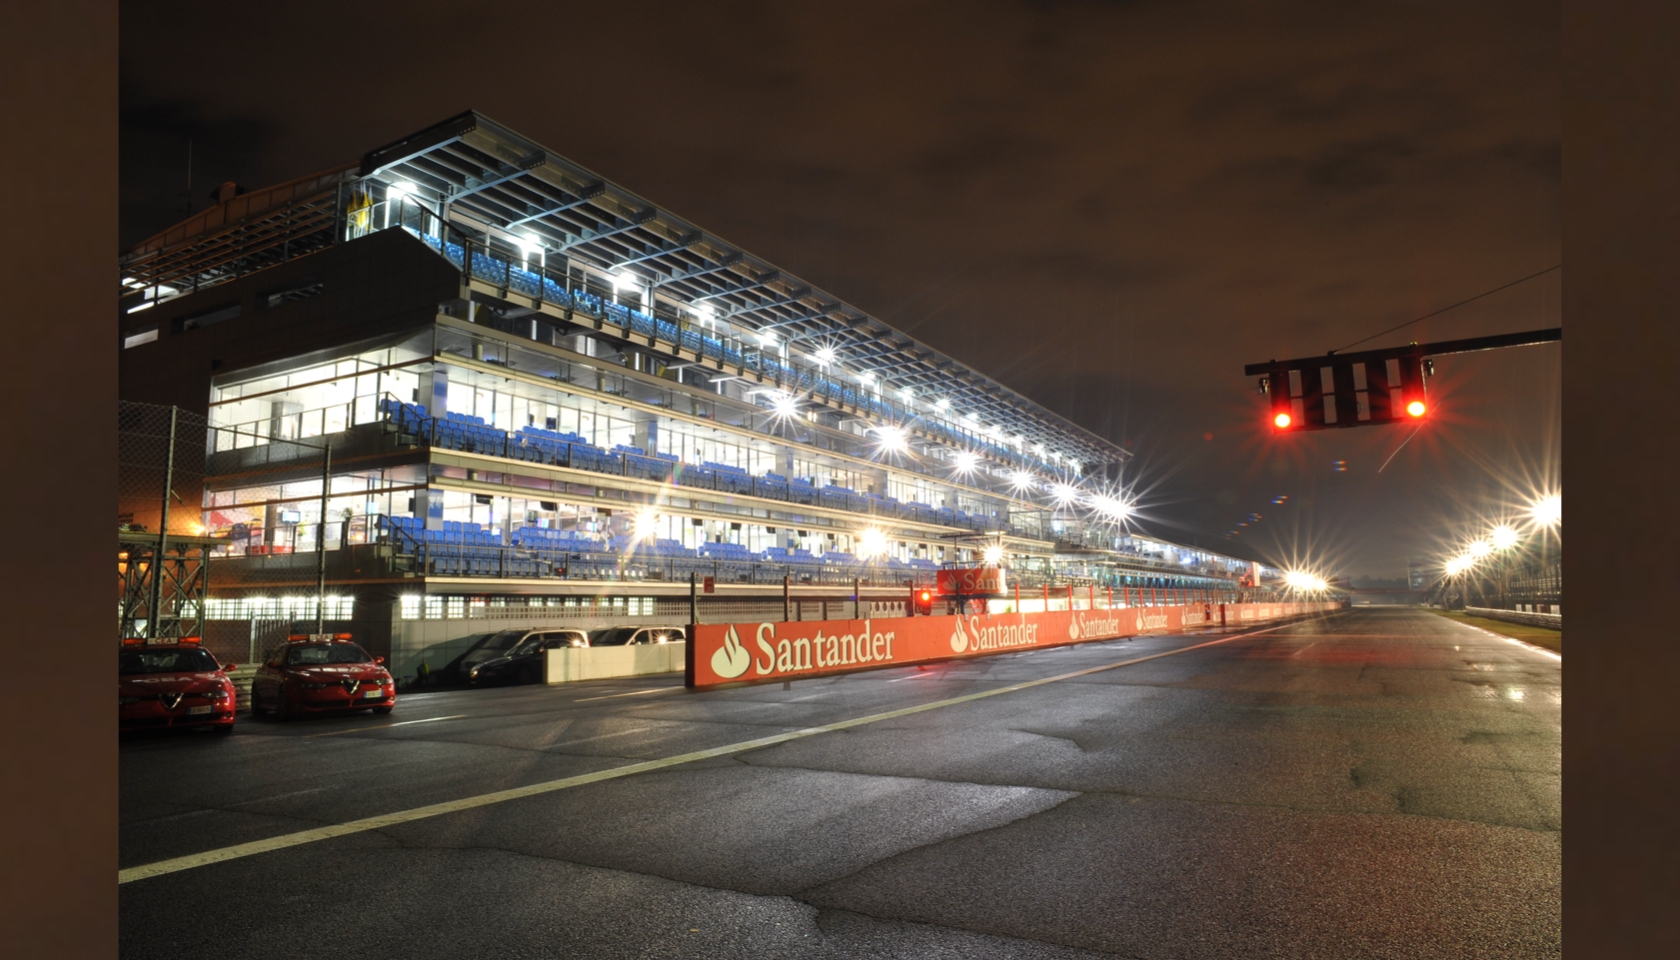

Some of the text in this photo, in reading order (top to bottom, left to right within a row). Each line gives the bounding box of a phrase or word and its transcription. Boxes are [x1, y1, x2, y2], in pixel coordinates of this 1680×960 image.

[970, 613, 1038, 651] Santander
[1079, 610, 1119, 639] Santander
[756, 619, 895, 675] Santander
